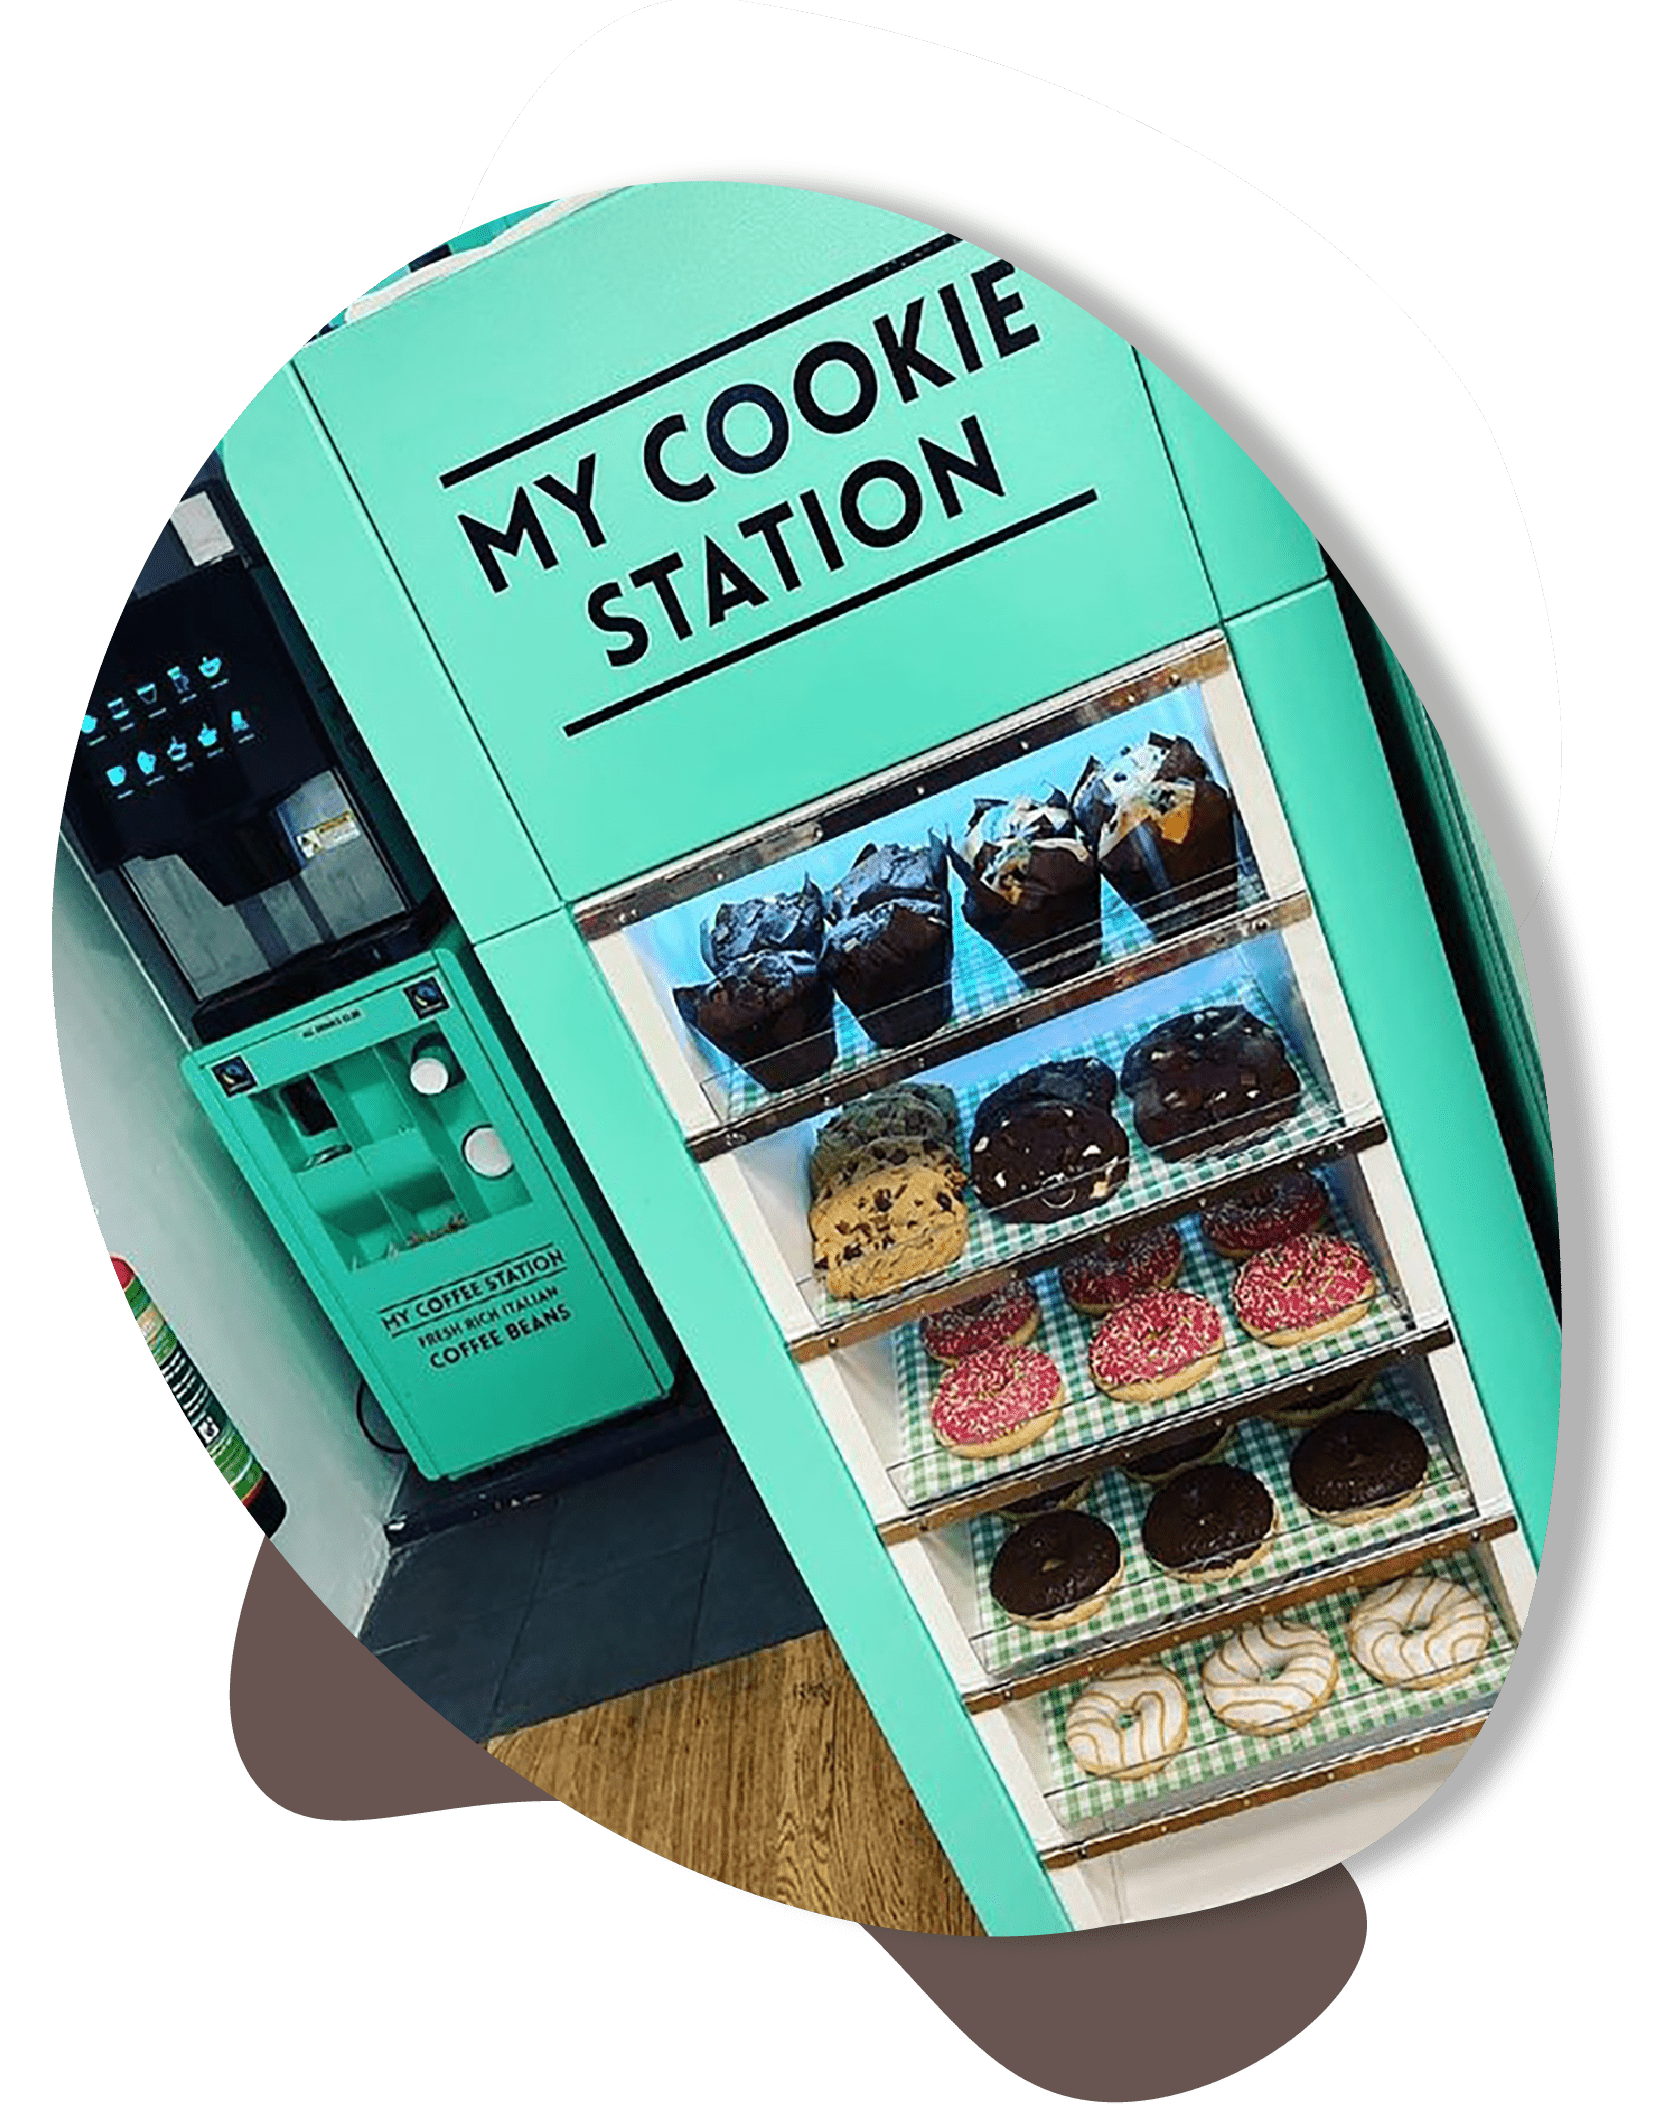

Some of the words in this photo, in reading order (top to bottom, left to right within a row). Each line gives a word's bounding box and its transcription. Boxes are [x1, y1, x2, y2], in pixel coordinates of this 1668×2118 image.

[457, 453, 606, 593] MY
[643, 259, 1040, 503] COOKIE
[587, 415, 1005, 668] STATION
[381, 1309, 410, 1331] MY
[416, 1282, 483, 1317] COFFEE
[485, 1249, 565, 1292] STATION
[418, 1321, 464, 1349] FRESH
[464, 1307, 500, 1331] RICH
[502, 1285, 560, 1316] ITALIAN
[430, 1330, 503, 1369] COFFEE
[505, 1303, 571, 1341] BEANS
